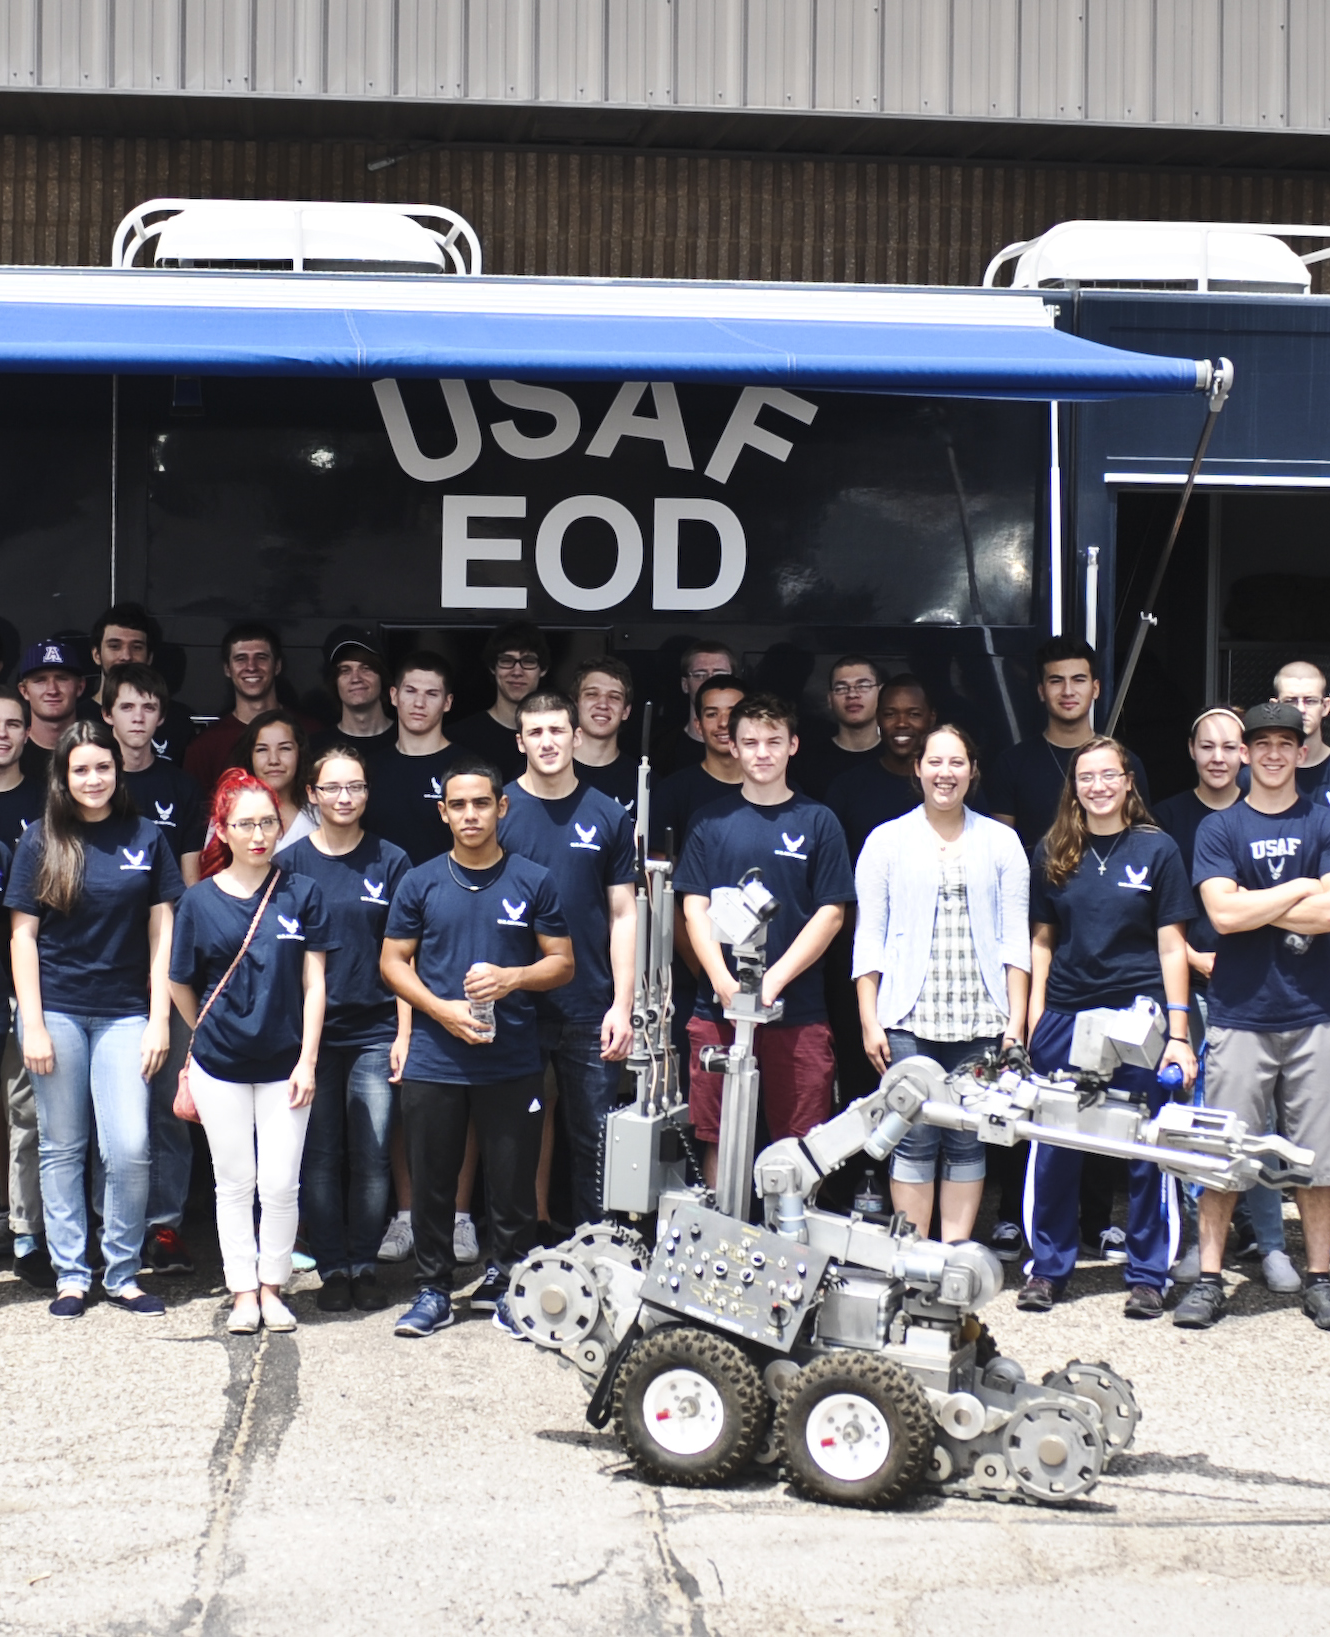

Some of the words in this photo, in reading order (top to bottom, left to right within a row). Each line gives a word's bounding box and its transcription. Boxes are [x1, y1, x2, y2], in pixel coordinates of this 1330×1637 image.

[372, 378, 819, 484] USAF
[441, 495, 747, 611] EOD
[1250, 837, 1302, 860] USAF
